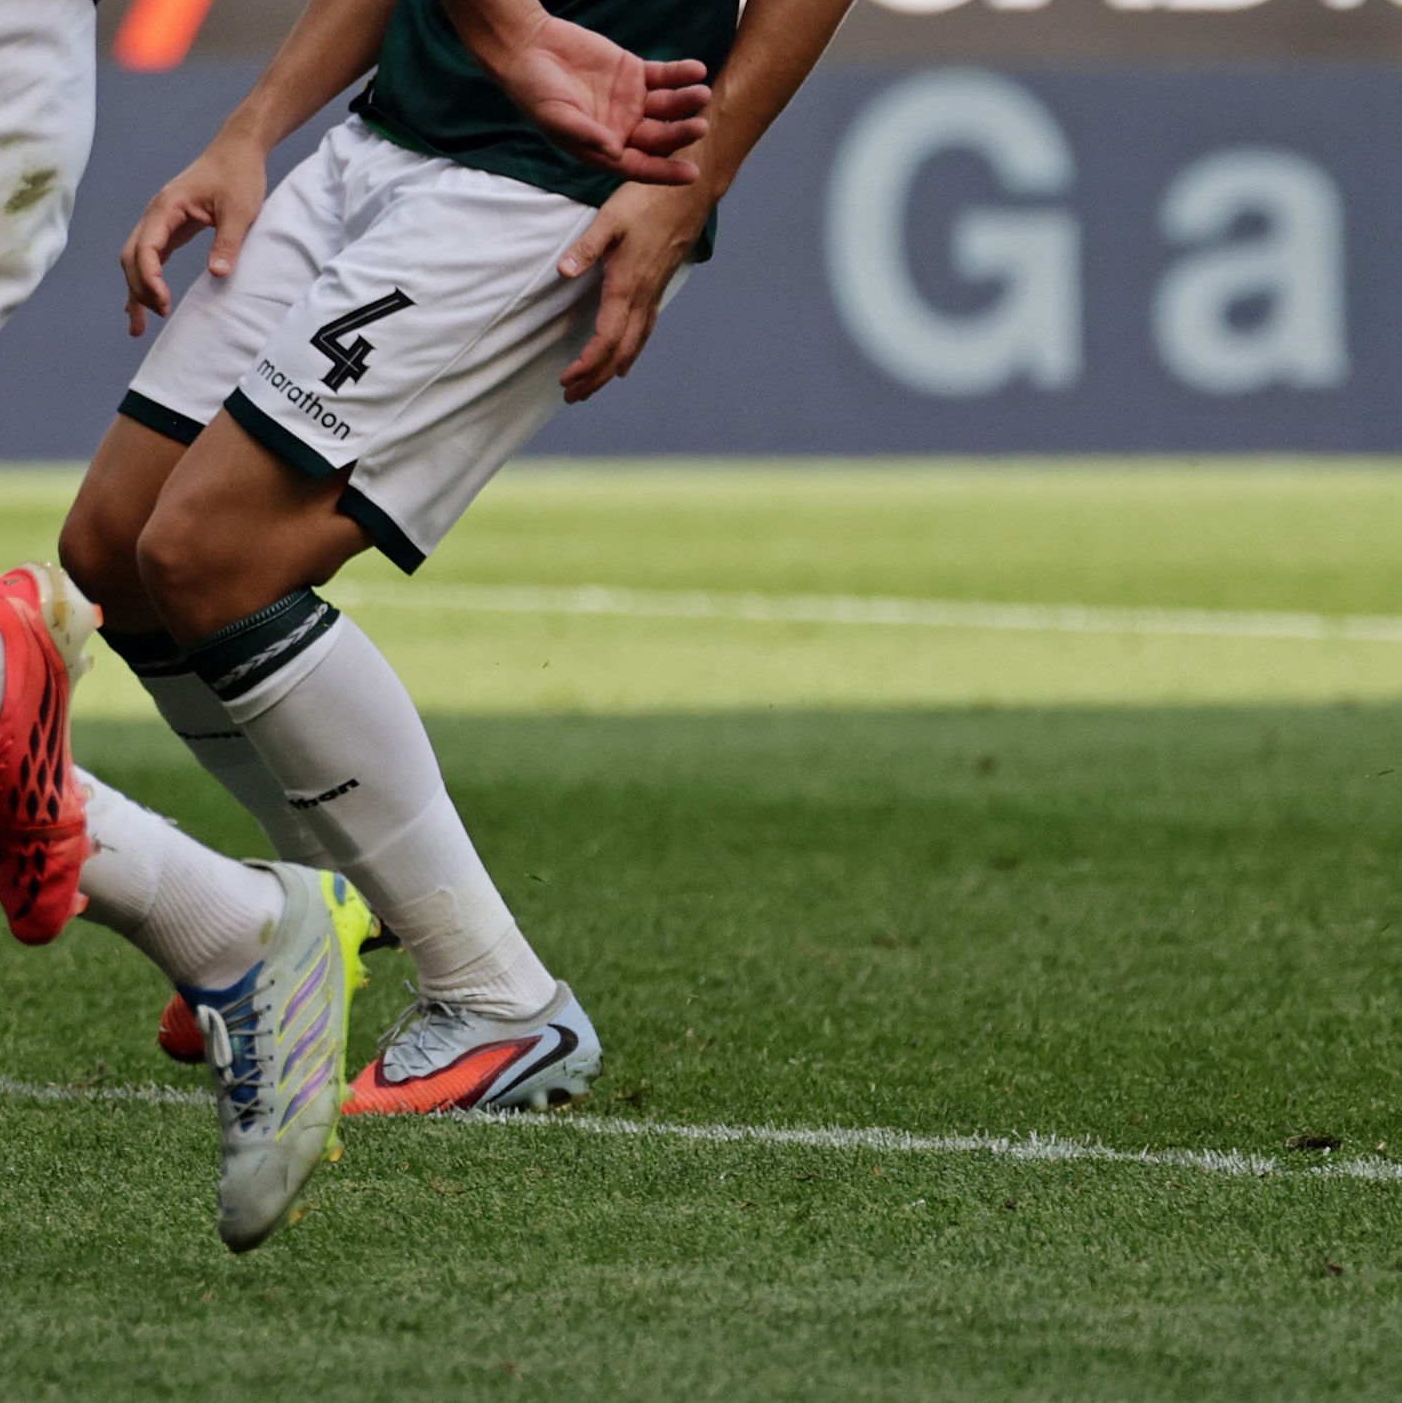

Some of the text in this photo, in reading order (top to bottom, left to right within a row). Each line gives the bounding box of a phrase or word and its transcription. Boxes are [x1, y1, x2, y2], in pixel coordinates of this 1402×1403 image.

[823, 66, 1351, 398] Ga
[309, 286, 418, 395] 4
[256, 358, 352, 441] marathon
